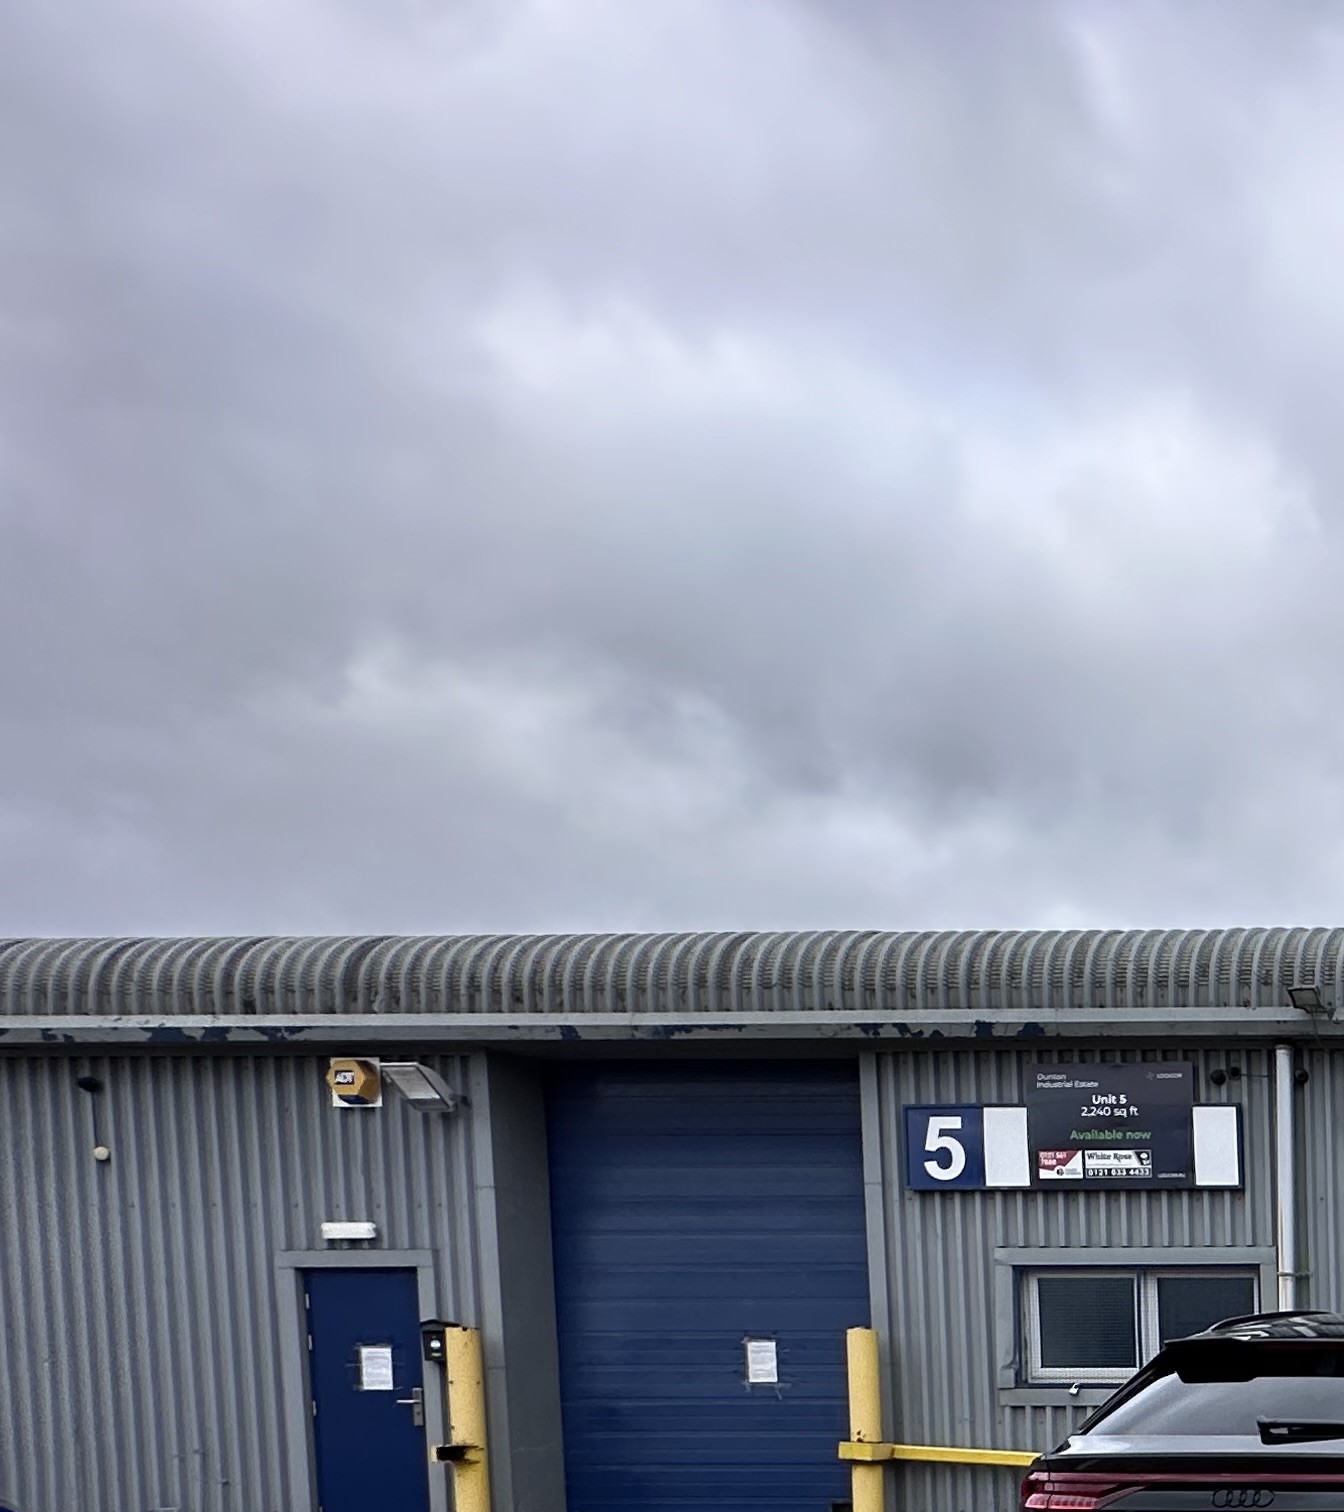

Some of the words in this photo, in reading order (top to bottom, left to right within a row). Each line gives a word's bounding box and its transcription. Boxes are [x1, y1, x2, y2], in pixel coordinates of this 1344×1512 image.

[1036, 1081, 1073, 1089] Industrial
[1074, 1080, 1099, 1088] Estate
[1092, 1094, 1117, 1105] Unit
[1119, 1094, 1128, 1105] 5
[1080, 1106, 1112, 1118] 2,240
[1113, 1108, 1127, 1118] sq
[1129, 1105, 1139, 1117] ft
[1070, 1129, 1123, 1140] Available
[1125, 1131, 1152, 1140] now
[923, 1116, 966, 1181] 5
[1087, 1152, 1112, 1160] White
[1088, 1168, 1108, 1176] 0121
